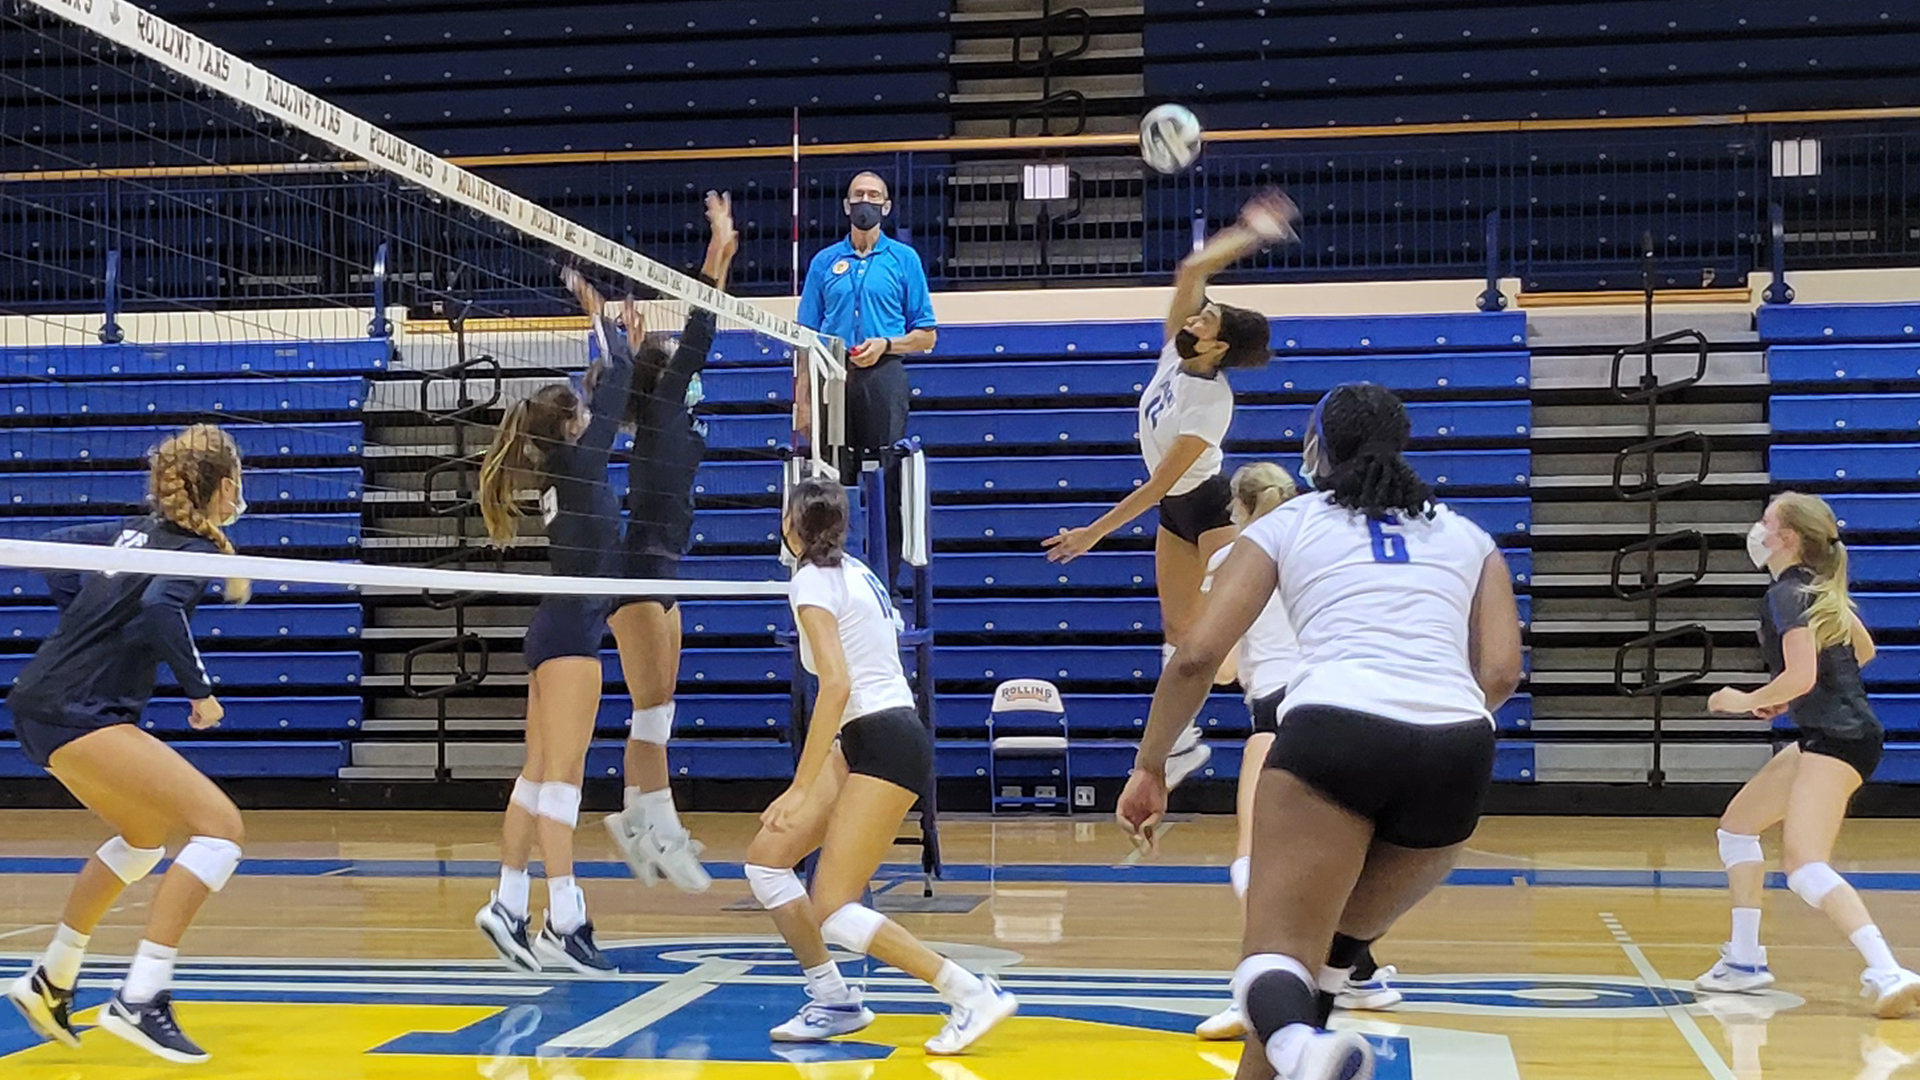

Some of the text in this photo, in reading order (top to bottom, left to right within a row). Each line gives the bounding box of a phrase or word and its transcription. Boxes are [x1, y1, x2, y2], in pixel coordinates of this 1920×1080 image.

[137, 11, 231, 82] ROLLINS TARS
[1367, 512, 1410, 564] 6
[1001, 685, 1053, 699] ROLLINS
